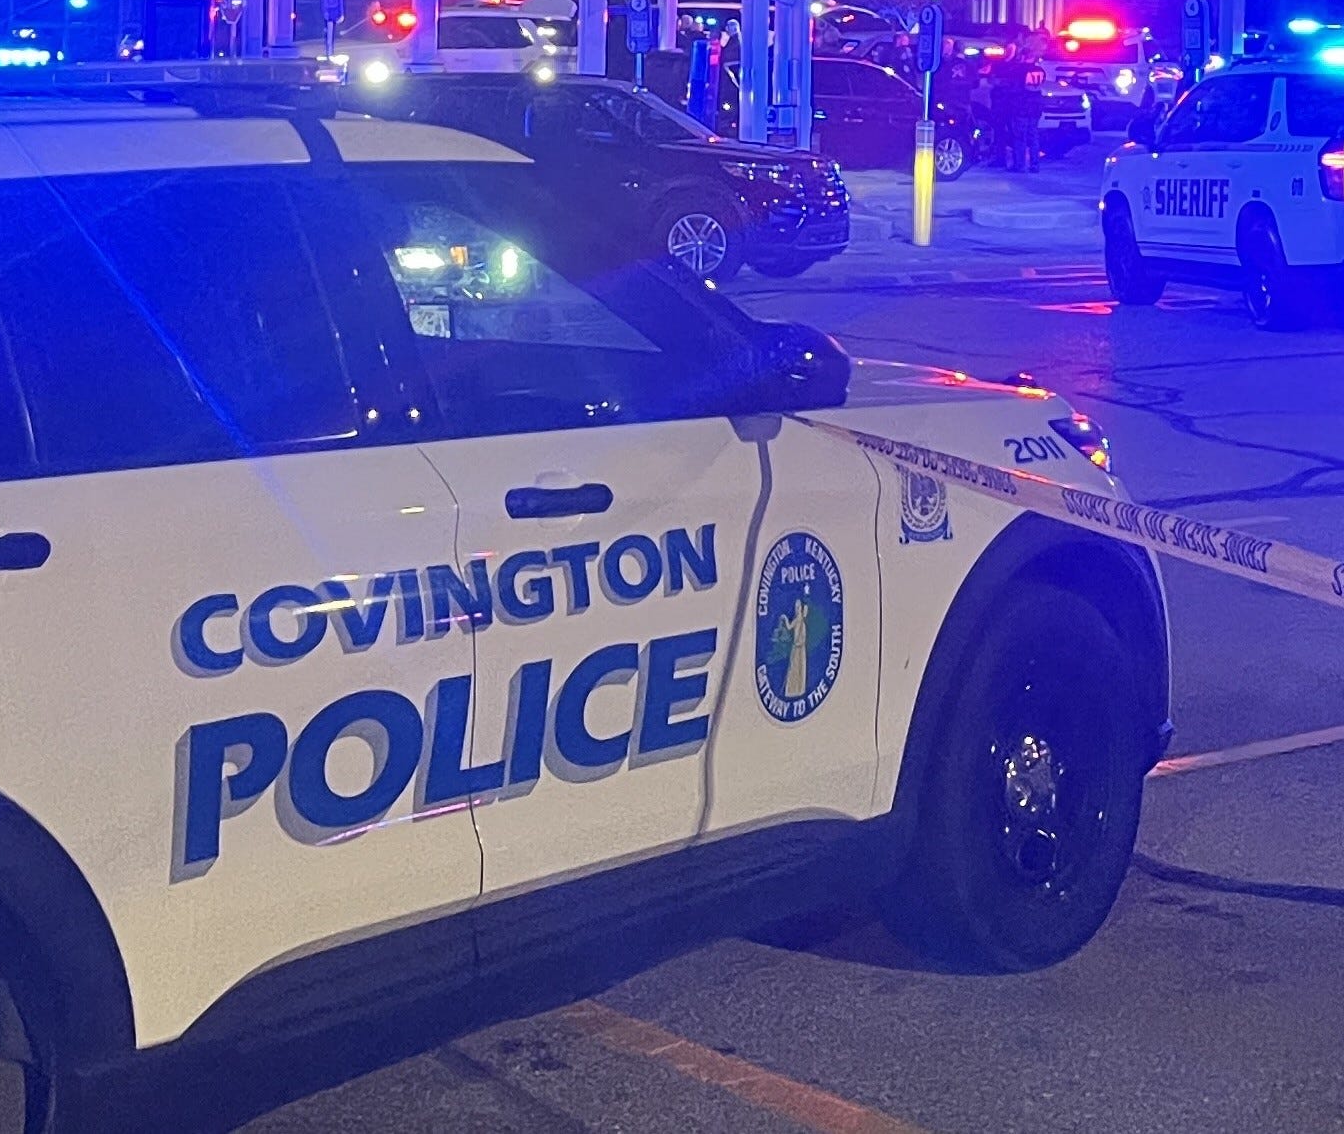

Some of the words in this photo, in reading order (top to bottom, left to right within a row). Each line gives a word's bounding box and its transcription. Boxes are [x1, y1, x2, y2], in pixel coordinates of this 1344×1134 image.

[1155, 178, 1230, 219] SHERIFF
[1003, 435, 1067, 464] 2011
[1061, 488, 1111, 526] CROSS
[1113, 501, 1144, 537] NOT
[1144, 509, 1167, 543] DO
[1169, 516, 1221, 558] SCENE
[1220, 530, 1272, 573] CRIME
[758, 538, 793, 616] COVINGTON
[804, 537, 842, 604] KENTUCKY
[781, 563, 816, 585] POLICE
[171, 523, 718, 678] COVINGTON
[756, 664, 791, 718] GATEWAY
[792, 699, 807, 717] TO
[807, 678, 830, 708] THE
[825, 623, 842, 680] SOUTH
[170, 627, 718, 886] POLICE
